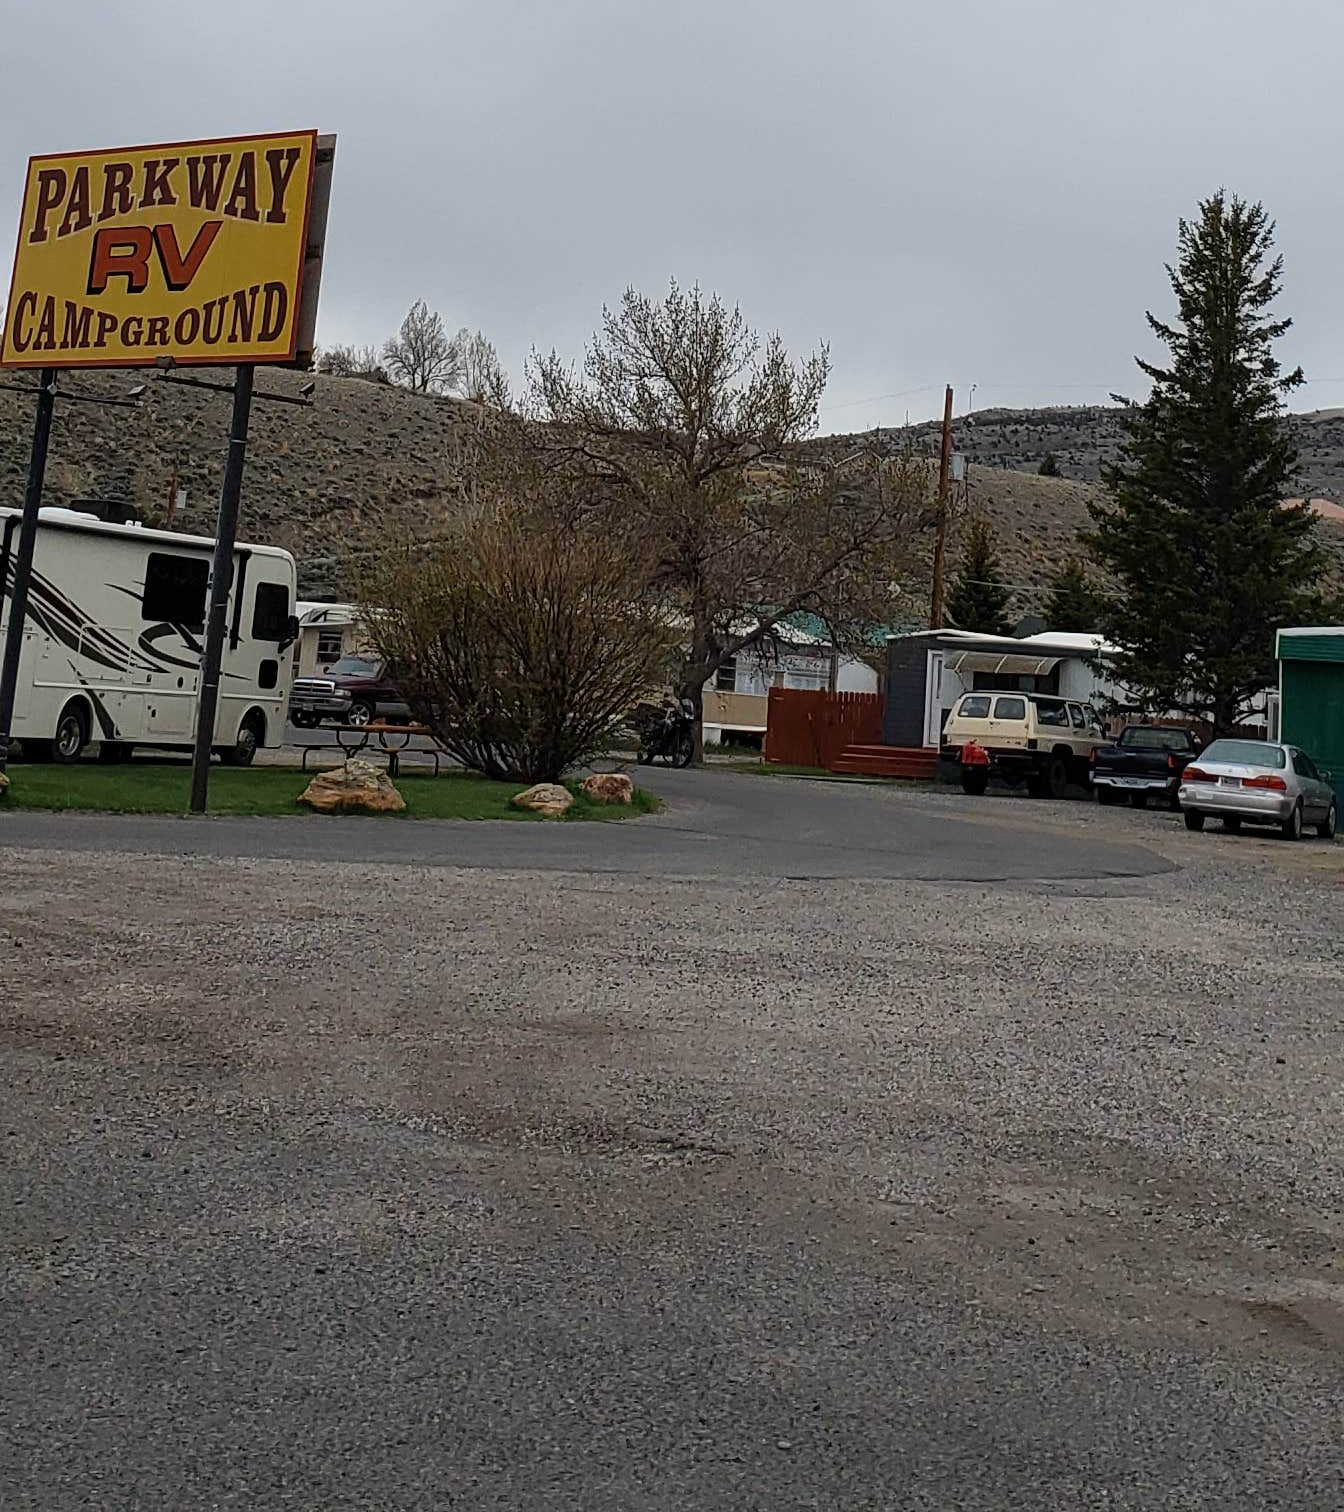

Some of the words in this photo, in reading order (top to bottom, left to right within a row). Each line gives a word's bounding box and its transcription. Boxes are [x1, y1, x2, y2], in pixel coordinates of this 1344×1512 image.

[28, 147, 301, 244] PARKWAY
[86, 220, 225, 296] RV
[12, 280, 288, 353] CAMPGROUND
